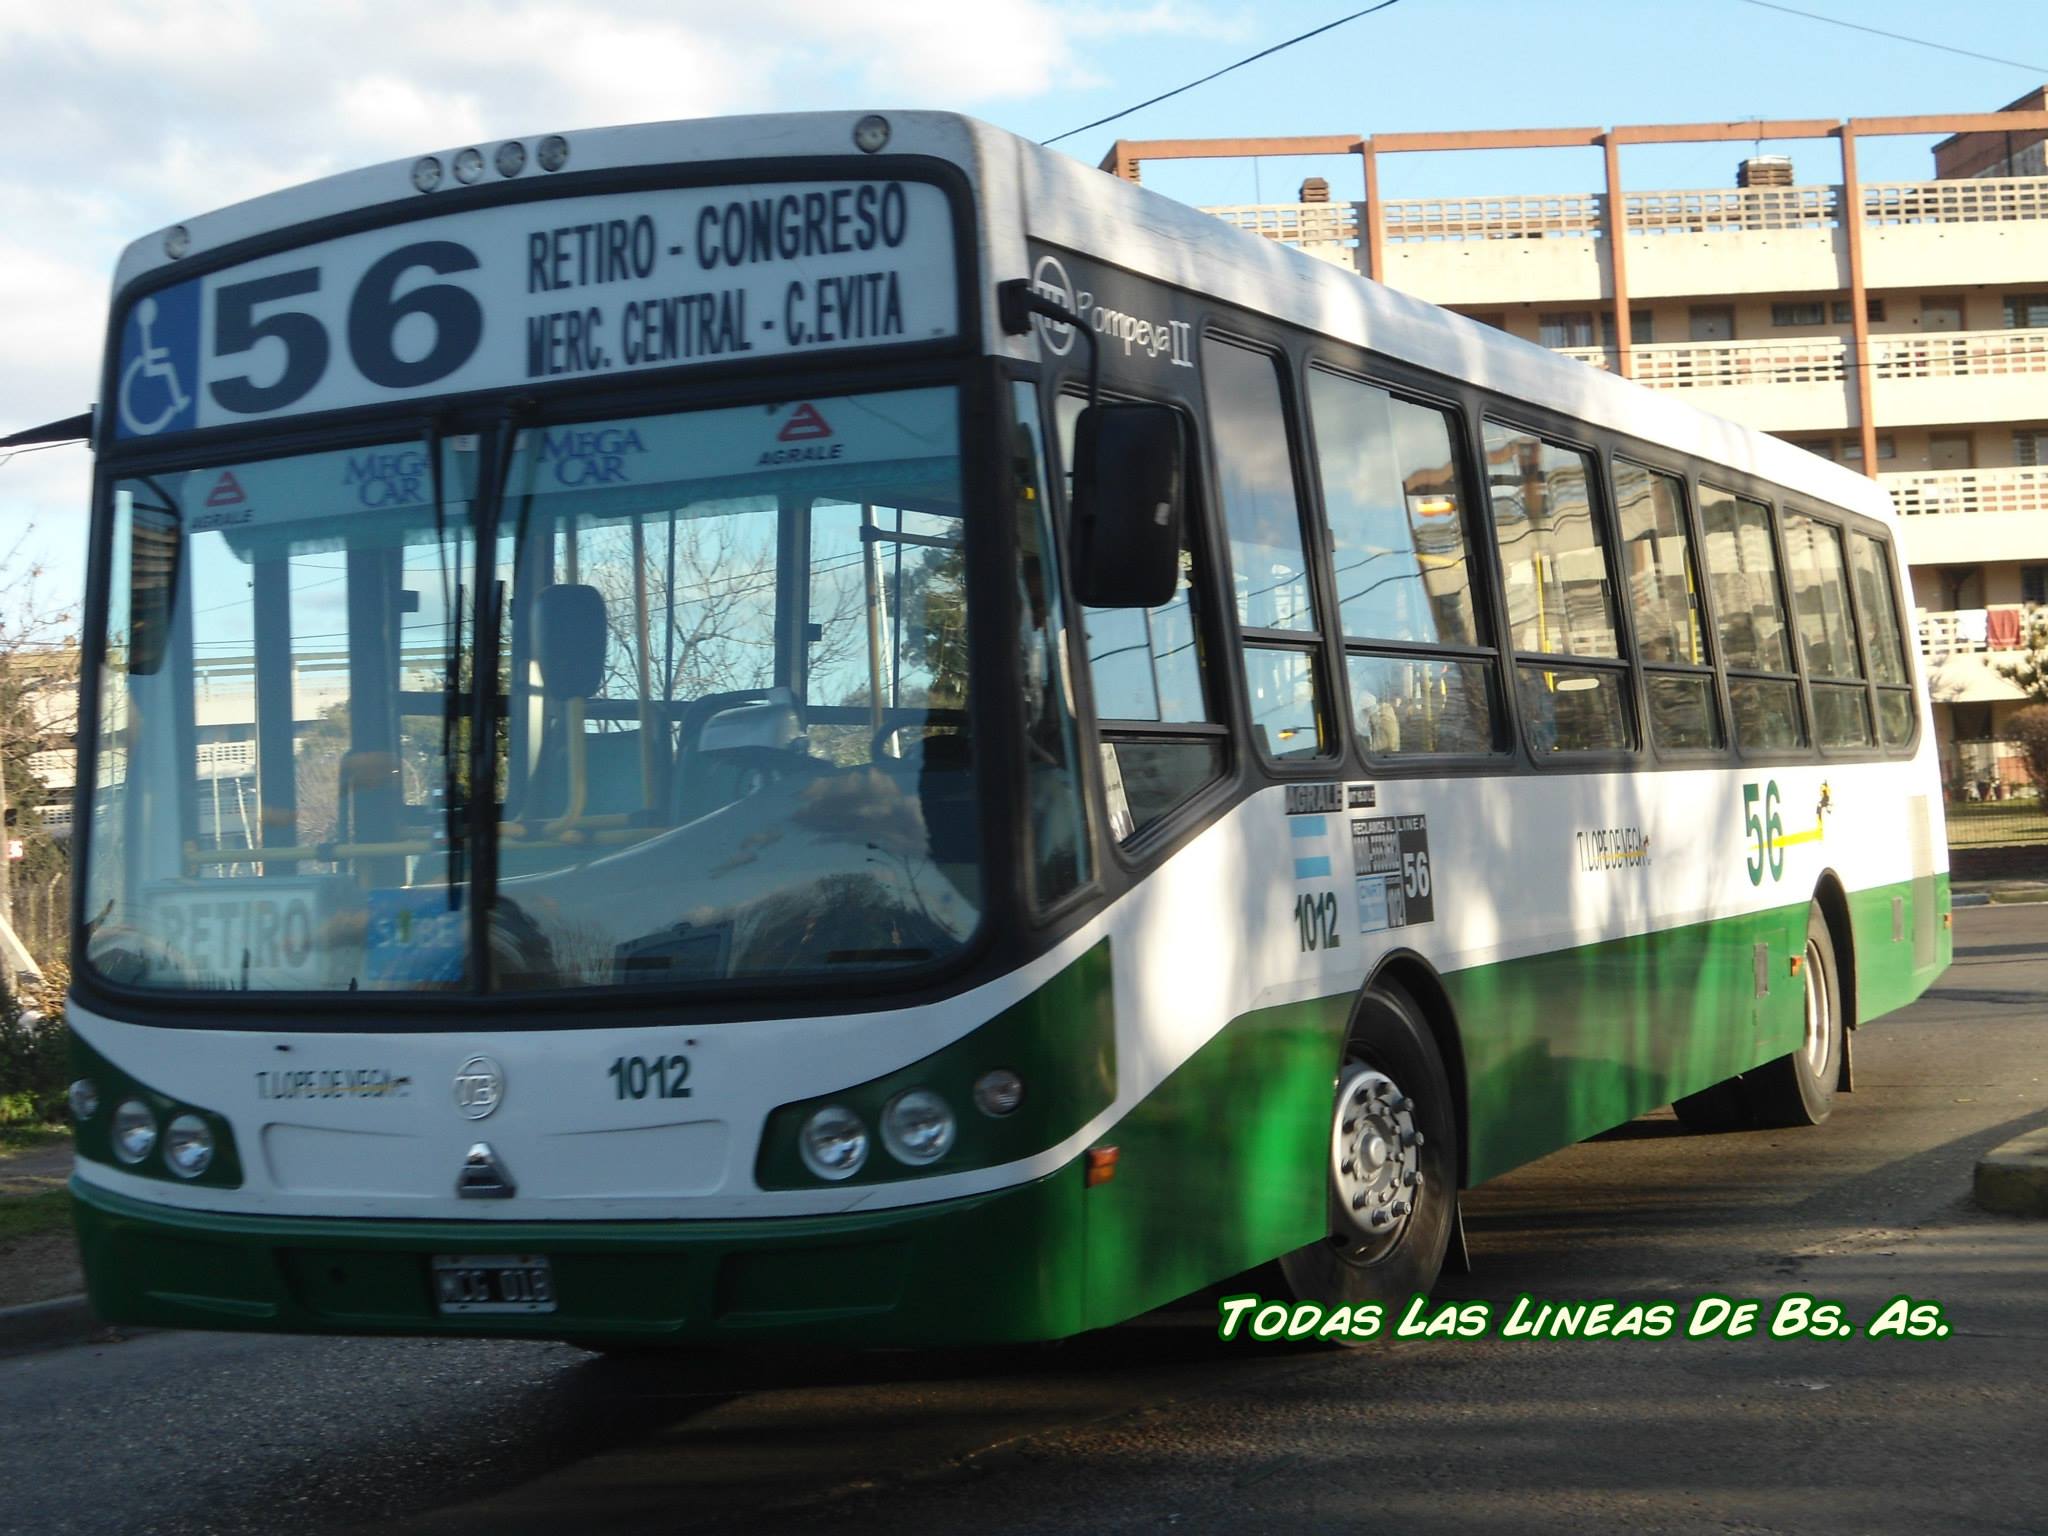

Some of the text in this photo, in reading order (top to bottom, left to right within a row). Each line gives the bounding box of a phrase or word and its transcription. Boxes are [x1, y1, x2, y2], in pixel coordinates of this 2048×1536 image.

[527, 213, 656, 294] RETIRO
[696, 181, 908, 270] CONGRESO
[207, 239, 485, 415] 56
[526, 306, 611, 378] MERC.
[622, 288, 752, 366] CENTRAL
[1077, 289, 1170, 358] Pompeya
[1168, 320, 1194, 368] II
[537, 428, 648, 463] MEGA
[756, 444, 845, 465] AGRALE
[358, 477, 424, 507] CAR
[554, 455, 630, 487] CAR
[192, 508, 254, 529] AGRALE
[1286, 783, 1342, 814] AGRALE
[1398, 817, 1426, 832] LINEA
[1742, 780, 1784, 887] 56
[1402, 852, 1430, 898] 56
[158, 897, 311, 972] RETIRO
[1294, 891, 1341, 952] 1012
[607, 1055, 692, 1100] 1012
